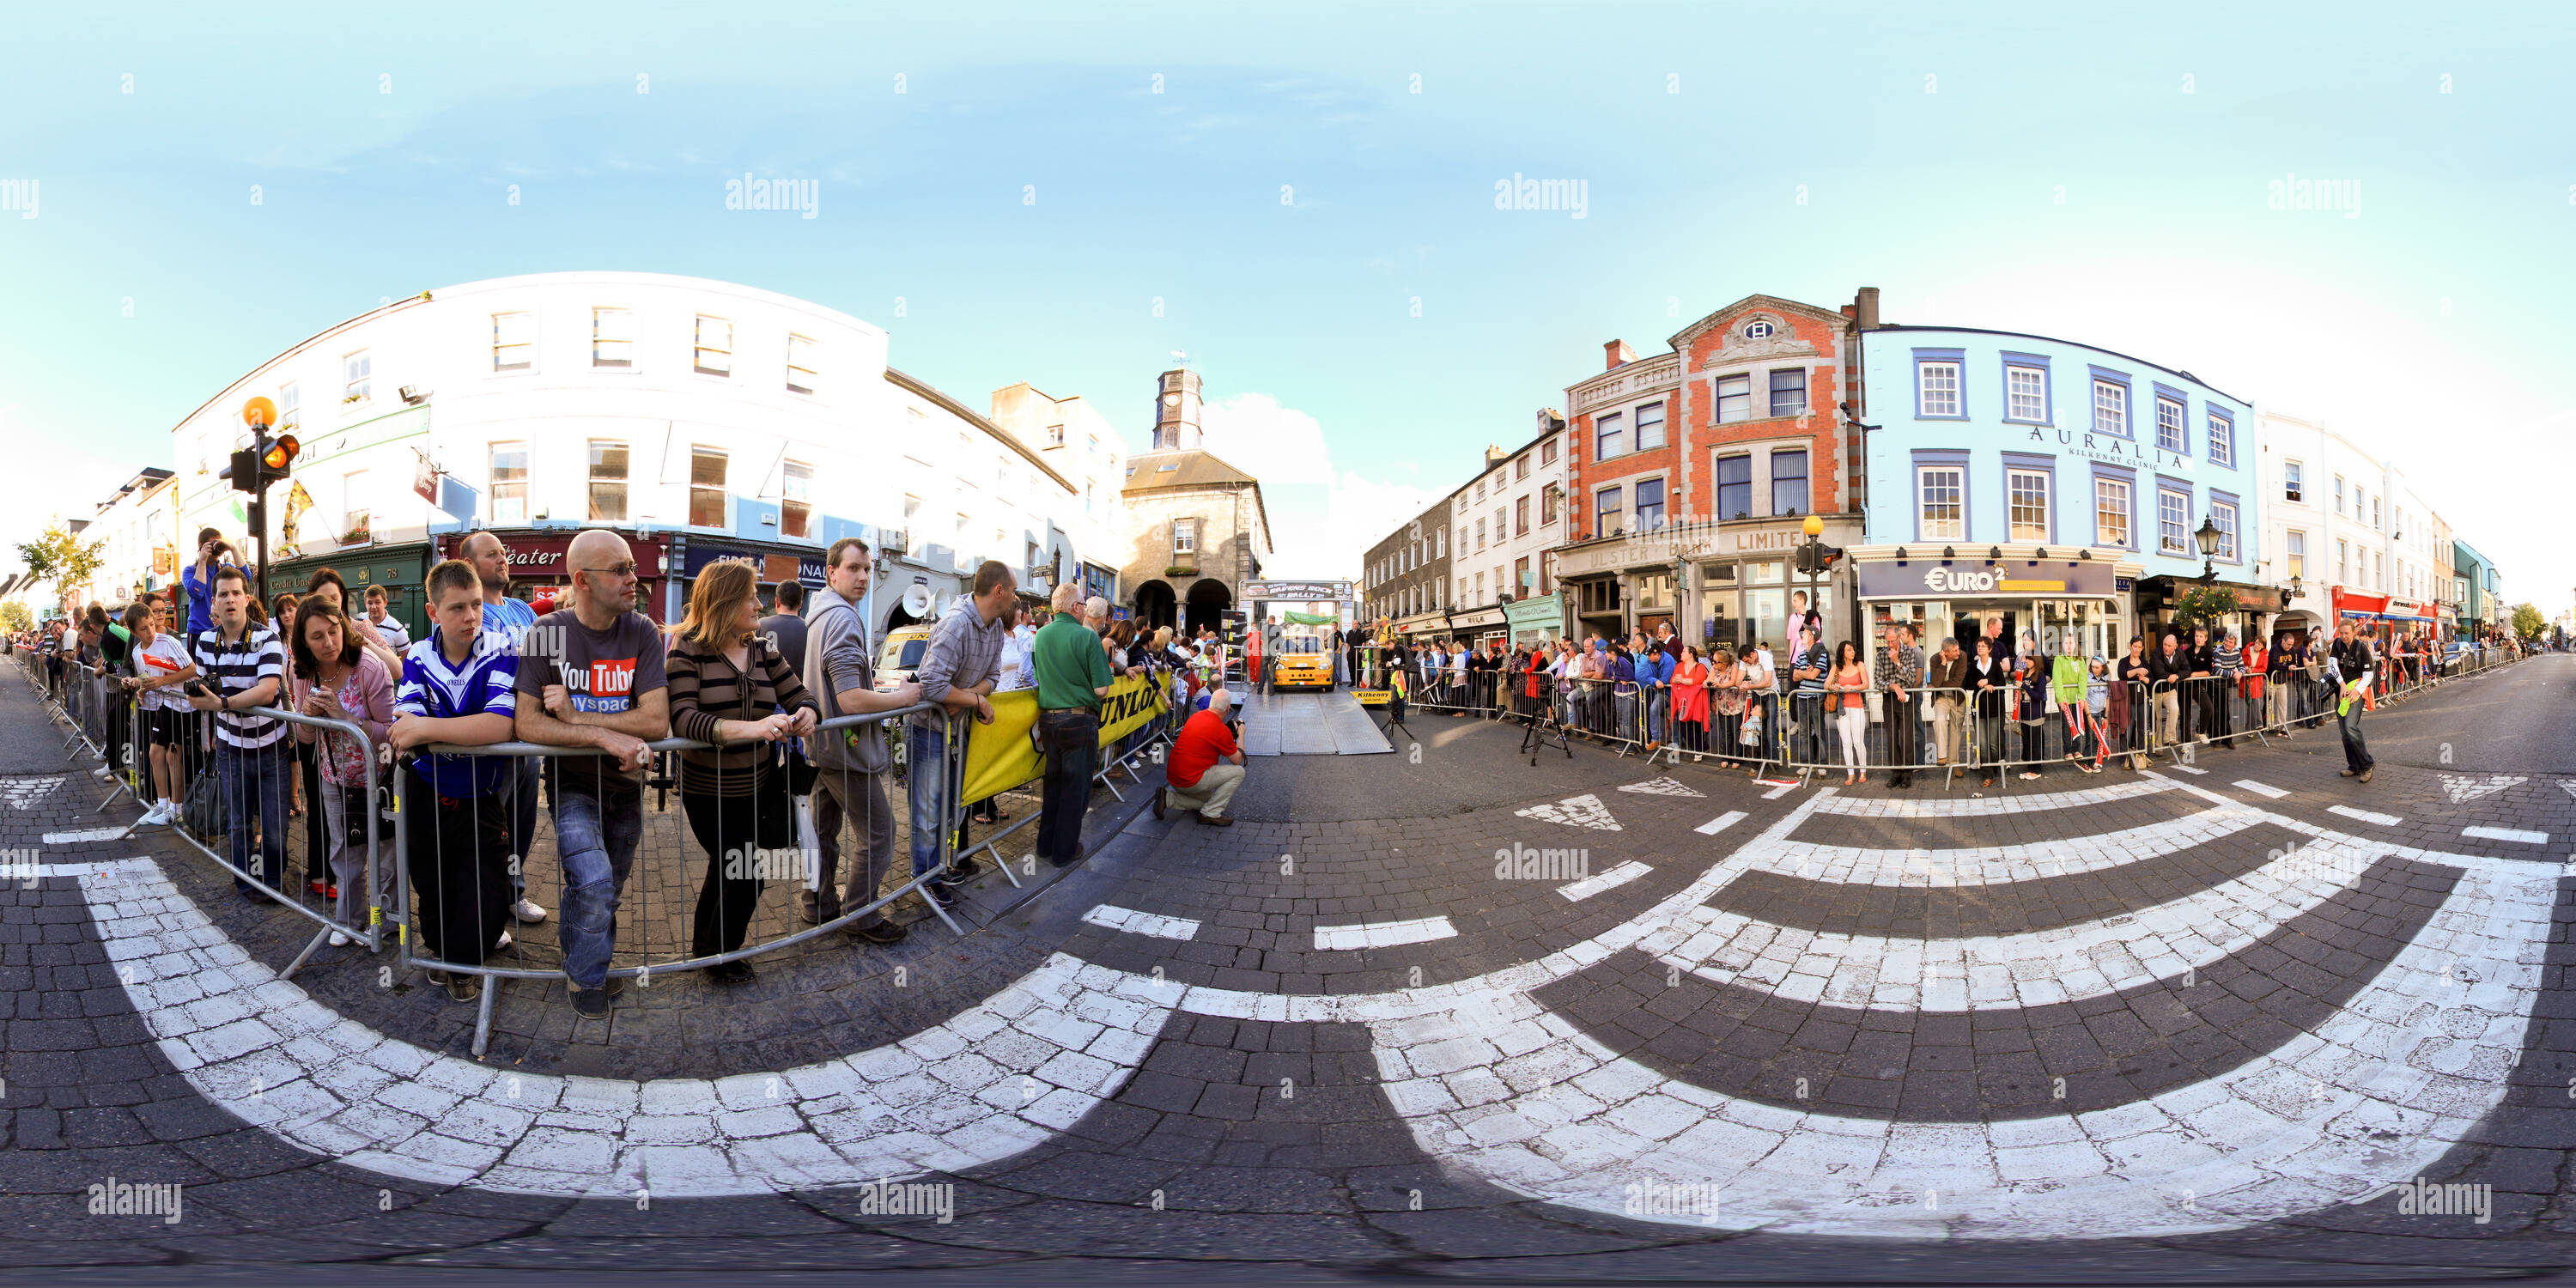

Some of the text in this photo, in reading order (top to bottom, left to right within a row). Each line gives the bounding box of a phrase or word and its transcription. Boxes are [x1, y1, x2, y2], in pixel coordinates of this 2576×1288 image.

[2029, 426, 2182, 469] AURALIA
[2069, 447, 2158, 471] KILKENNY CLINIC
[1590, 546, 1648, 568] ULSTER
[1669, 538, 1713, 557] BANK
[270, 576, 311, 589] Credit Unio
[387, 568, 398, 579] 78
[558, 662, 590, 691] You
[570, 696, 629, 713] yspac
[1098, 686, 1159, 729] UNLO
